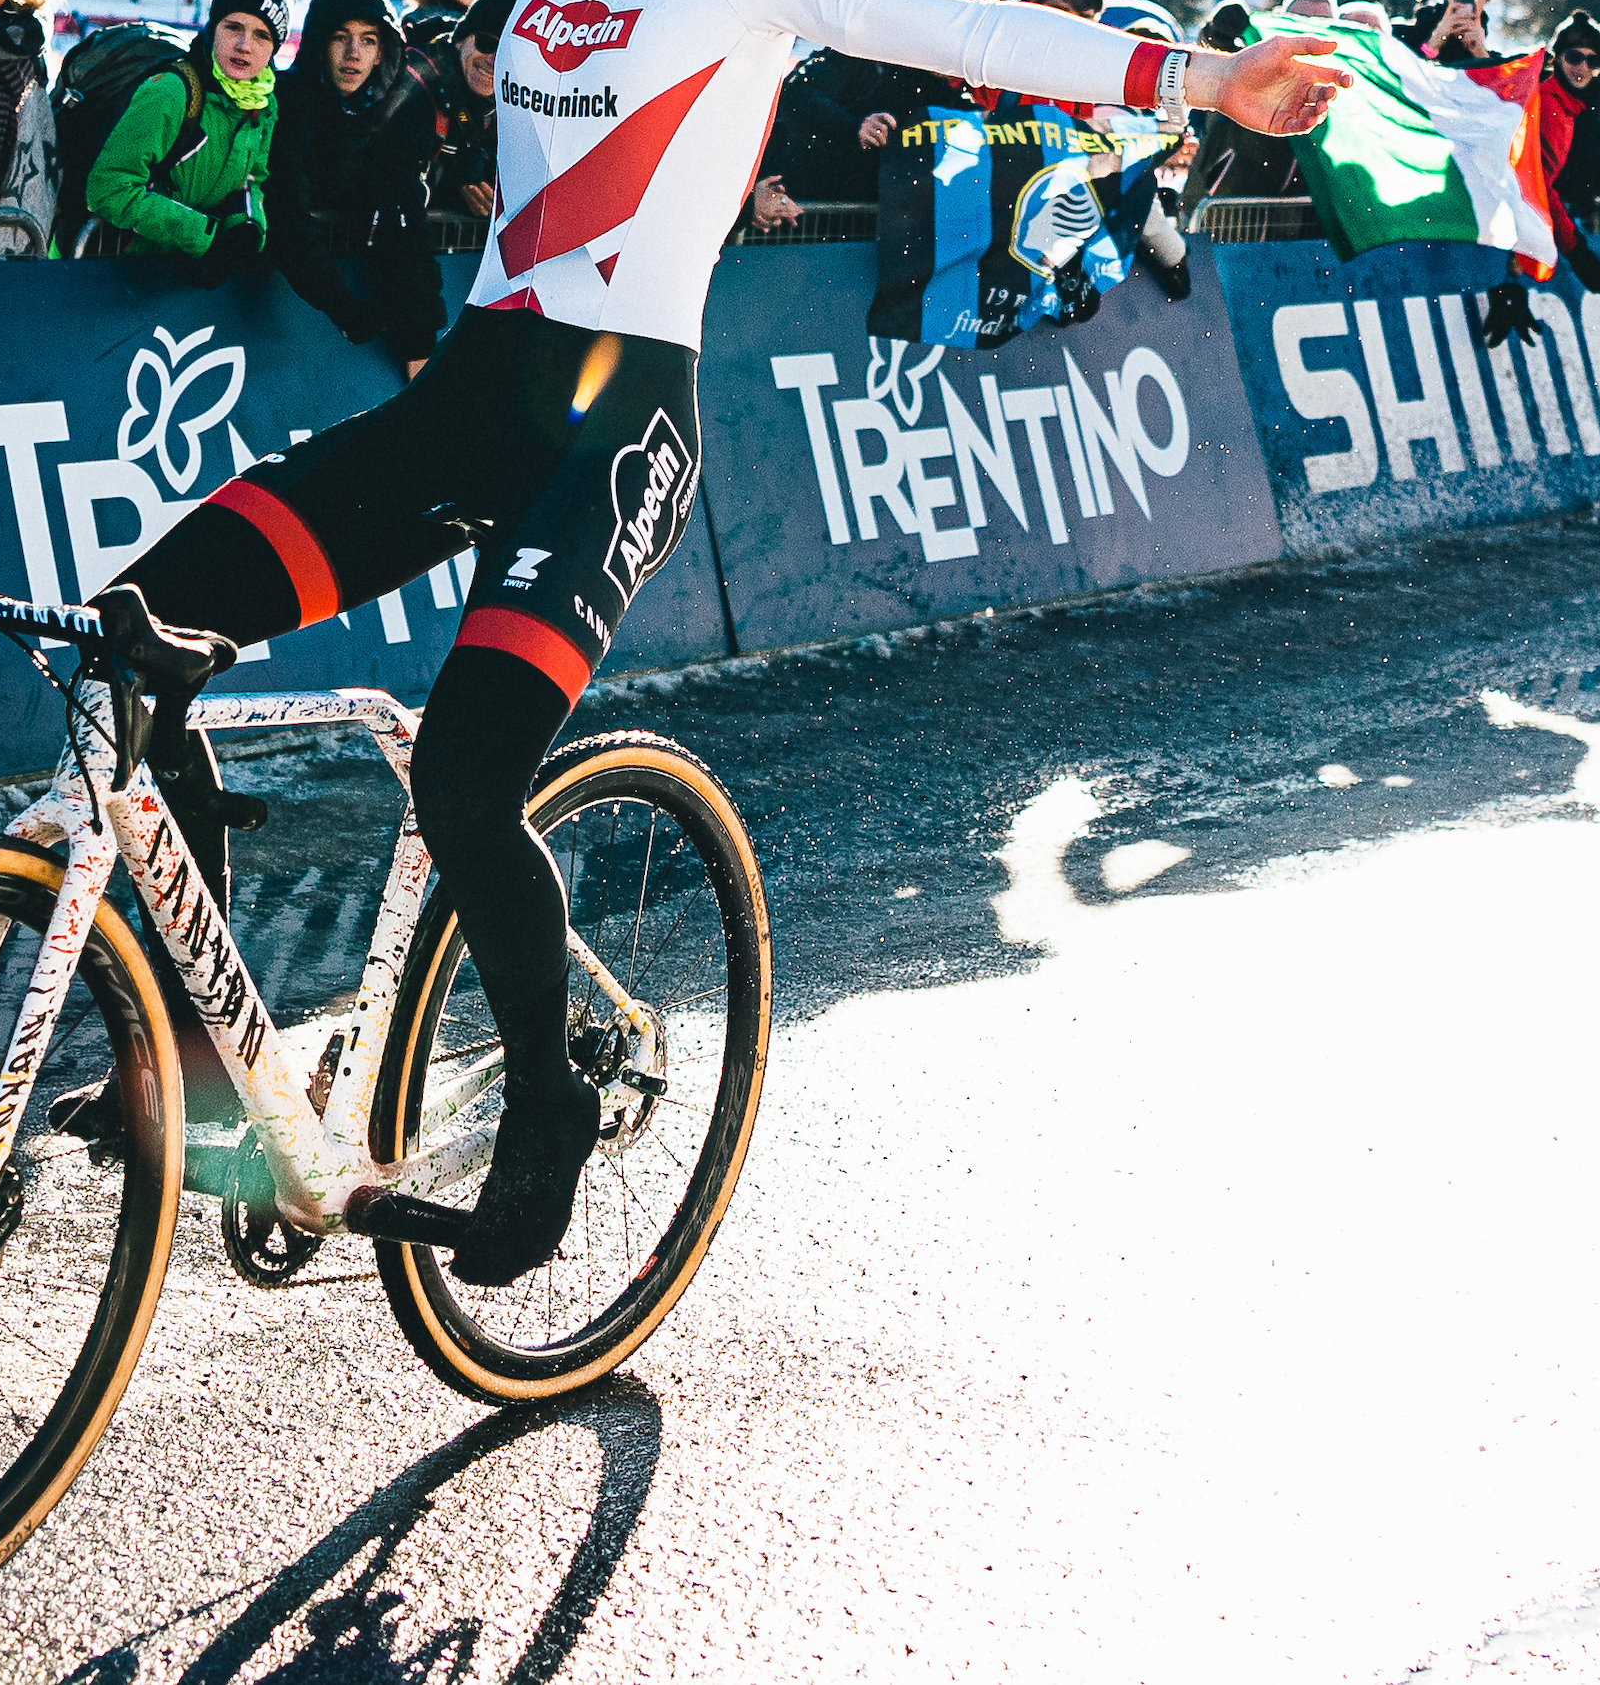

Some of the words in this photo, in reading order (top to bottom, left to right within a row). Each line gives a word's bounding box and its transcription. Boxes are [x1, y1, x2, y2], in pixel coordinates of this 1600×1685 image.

[521, 5, 626, 53] Alpecin
[501, 71, 619, 118] deceuninck
[771, 346, 1189, 563] TRENTINO
[619, 442, 680, 585] Alpecin
[502, 577, 532, 592] ZWIFT
[147, 817, 266, 1070] CANYON
